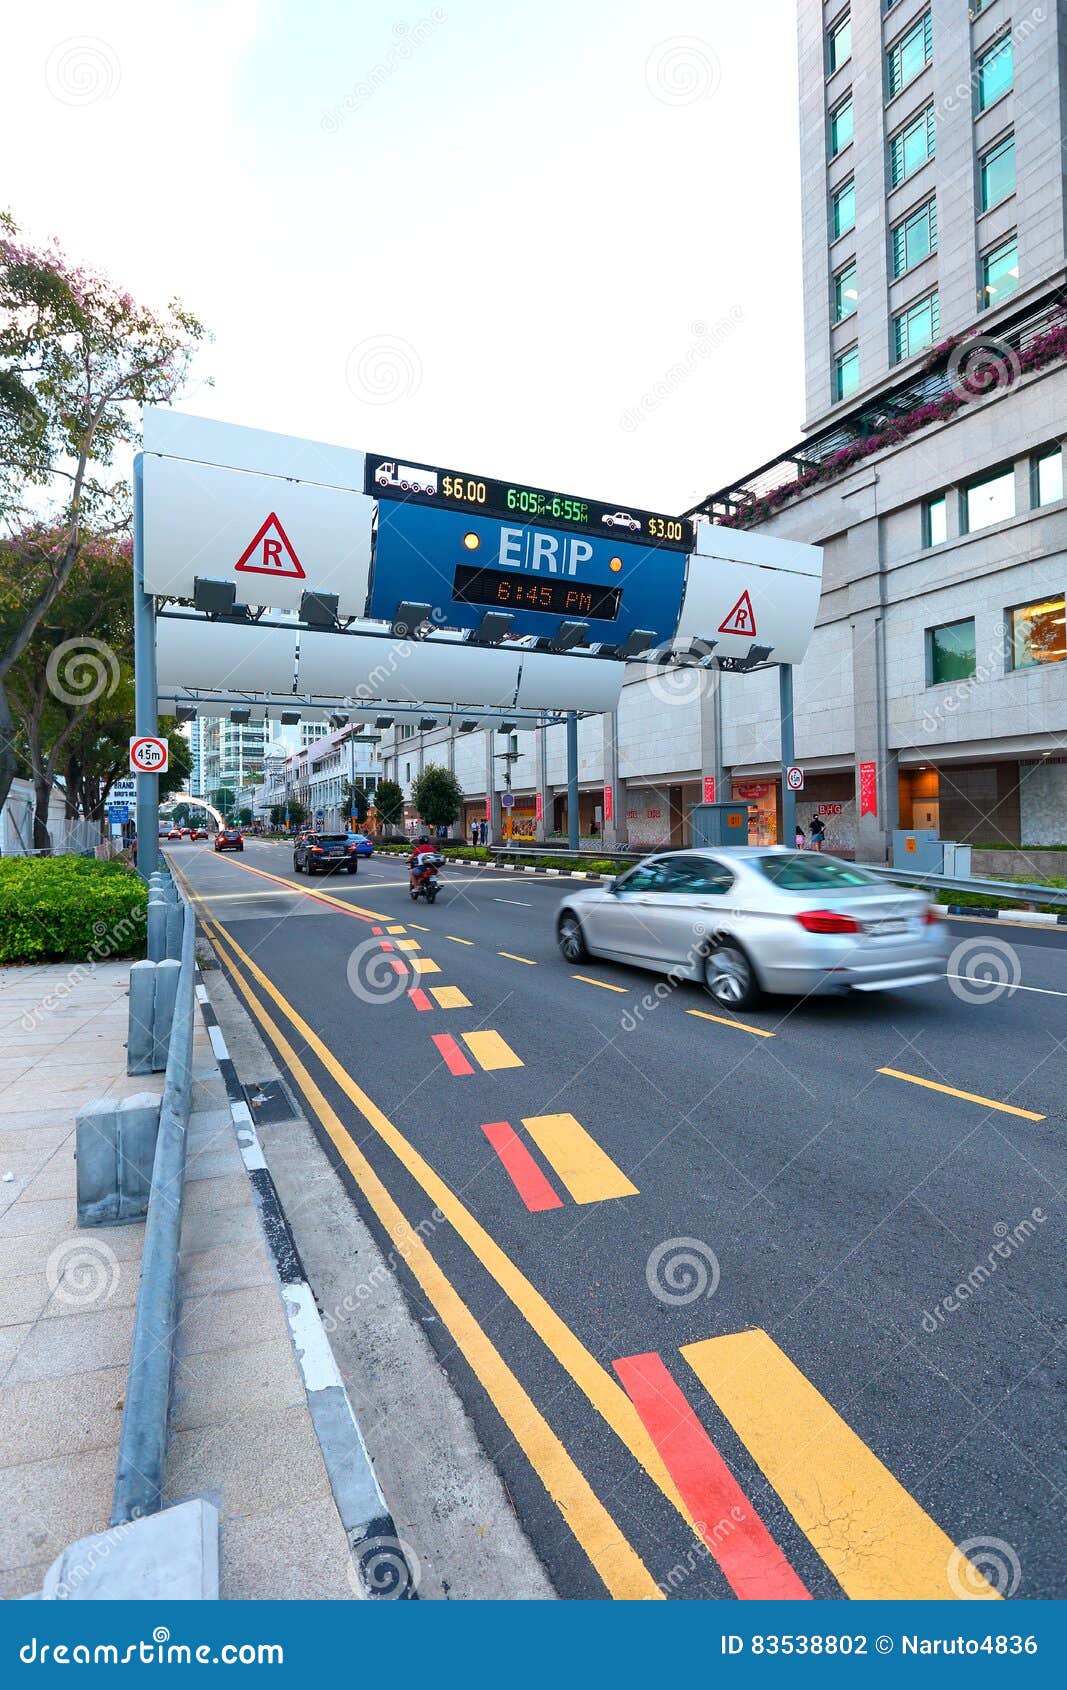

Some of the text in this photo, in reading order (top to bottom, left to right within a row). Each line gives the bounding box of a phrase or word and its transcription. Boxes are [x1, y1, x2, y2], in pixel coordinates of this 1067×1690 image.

[442, 476, 486, 503] $6.00
[648, 518, 683, 541] $3.00
[263, 538, 283, 568] R
[497, 580, 593, 612] 6:45 PM
[734, 608, 748, 629] R
[819, 804, 842, 814] BHG
